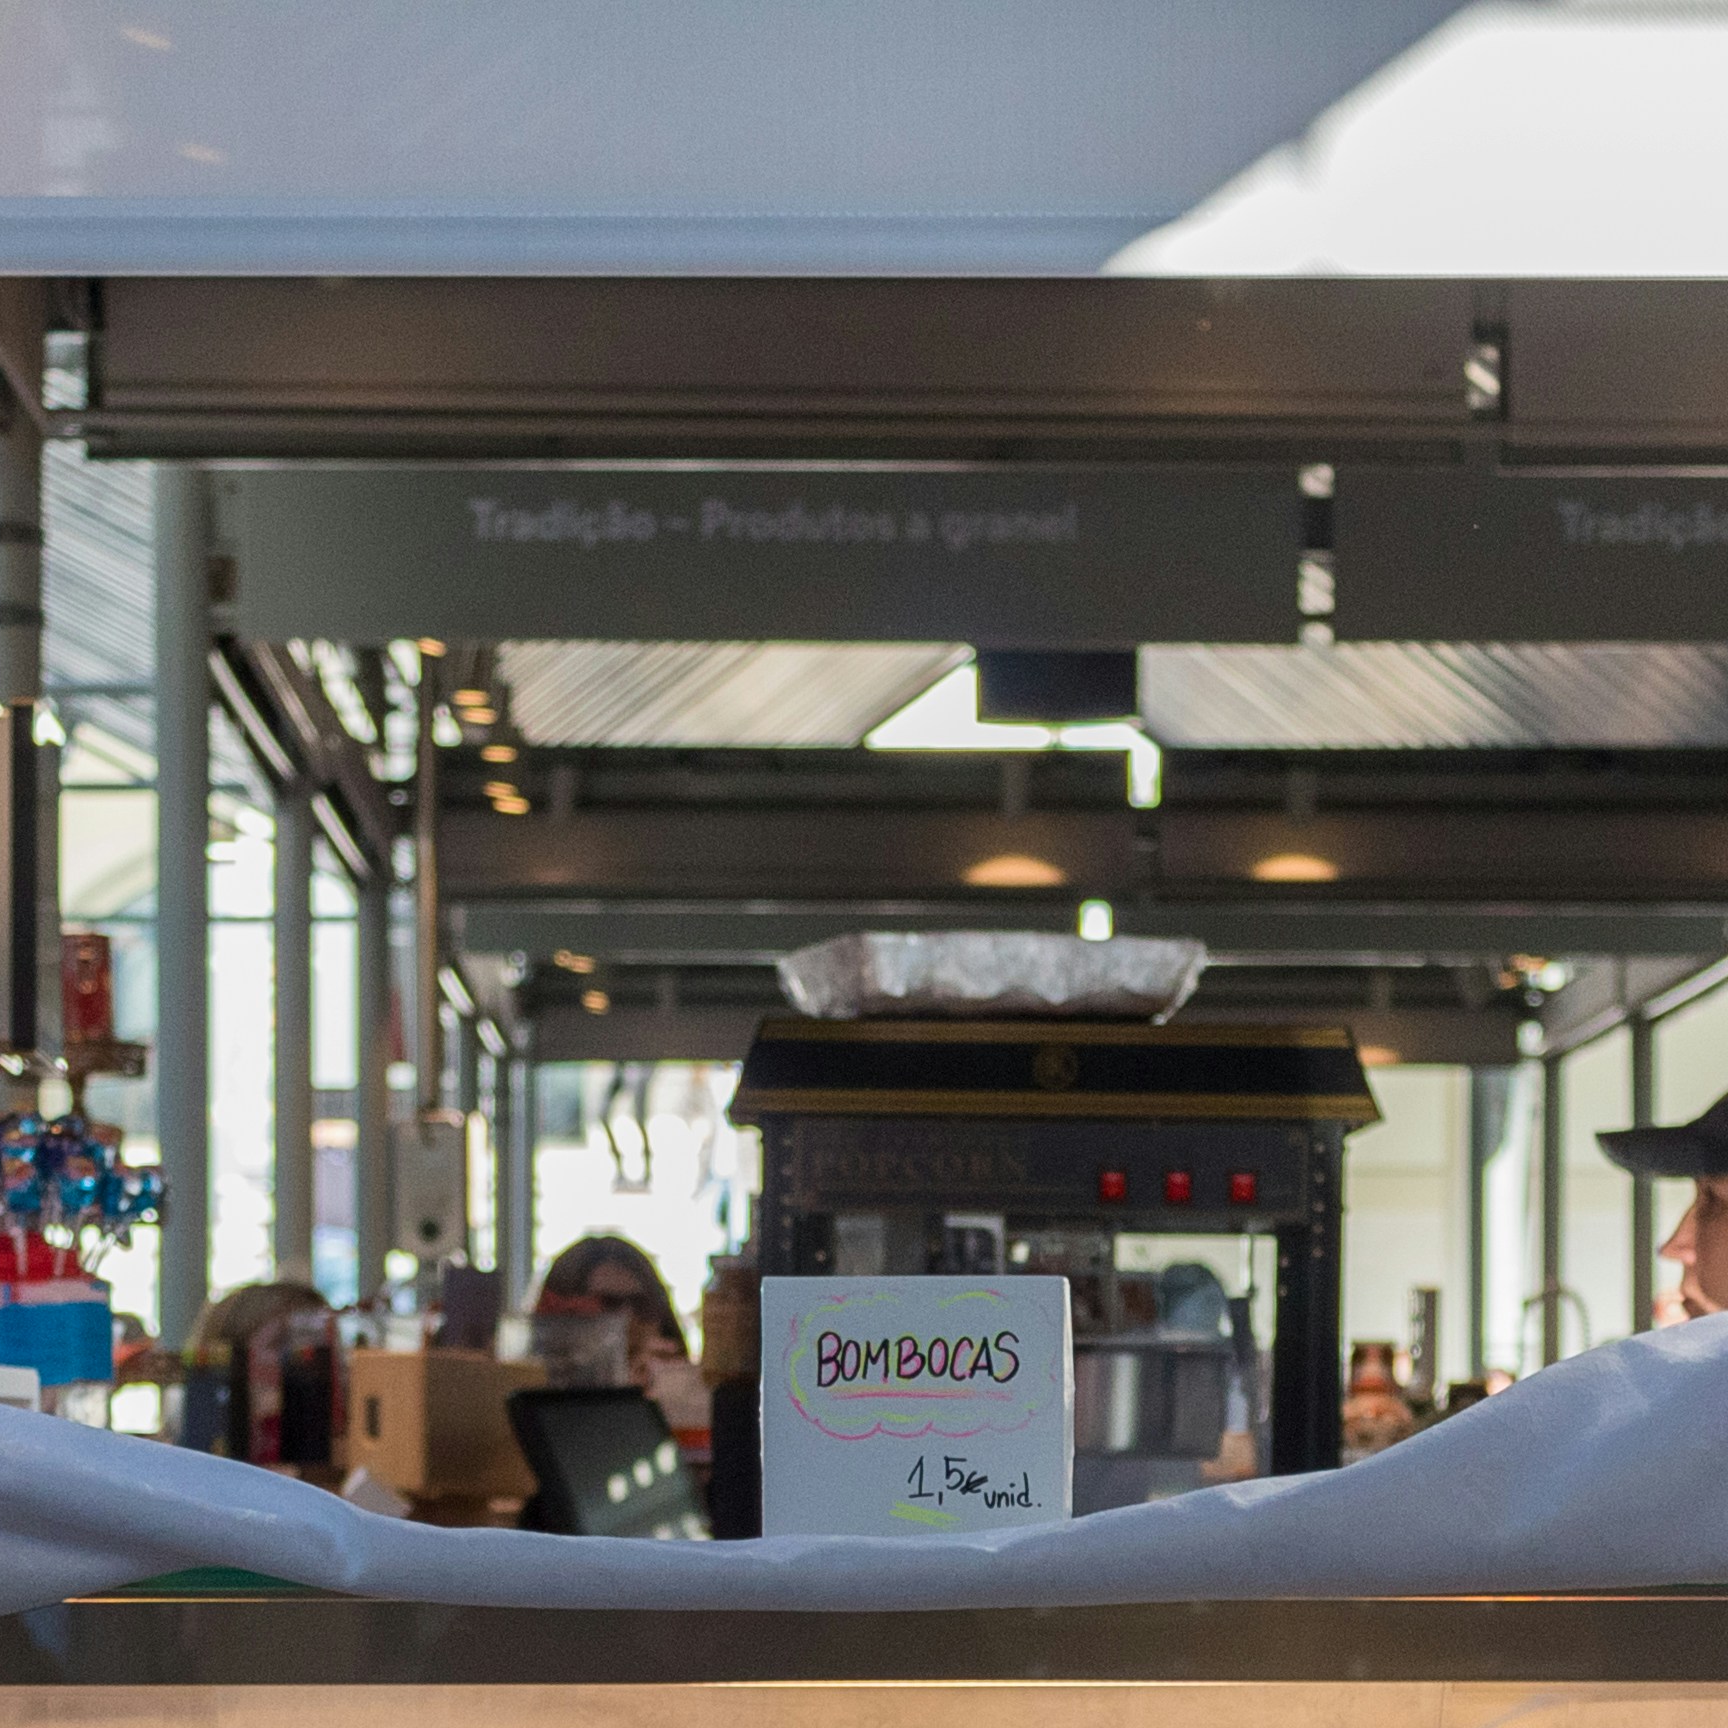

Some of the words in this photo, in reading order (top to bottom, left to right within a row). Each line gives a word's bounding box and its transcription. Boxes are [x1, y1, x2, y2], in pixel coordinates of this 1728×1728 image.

[473, 497, 657, 546] Tradição
[701, 498, 898, 542] Produtos
[906, 511, 935, 541] a
[945, 504, 1077, 551] granel
[816, 1331, 1020, 1389] BOMBOCAS
[983, 1471, 1043, 1510] unid.
